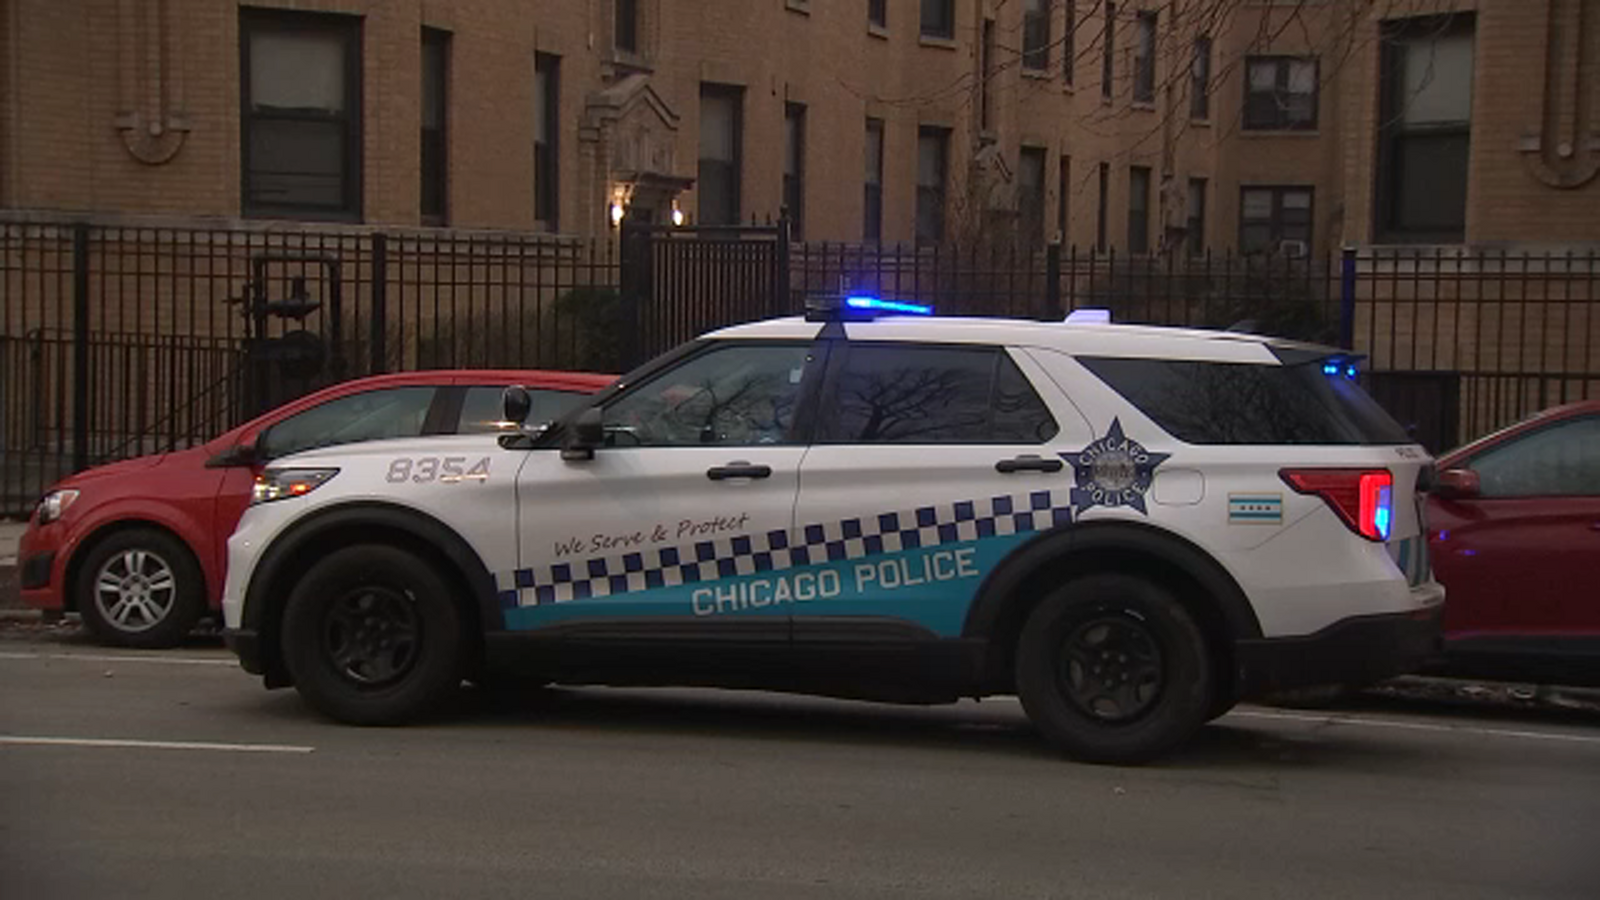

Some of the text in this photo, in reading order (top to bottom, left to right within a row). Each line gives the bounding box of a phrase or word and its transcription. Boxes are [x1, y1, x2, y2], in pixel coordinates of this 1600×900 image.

[1080, 438, 1149, 466] CHICAGO
[385, 457, 491, 483] 8354
[1081, 481, 1146, 506] POLICE
[554, 512, 750, 557] We Serve & Protect
[692, 547, 980, 616] CHICAGO POLICE
